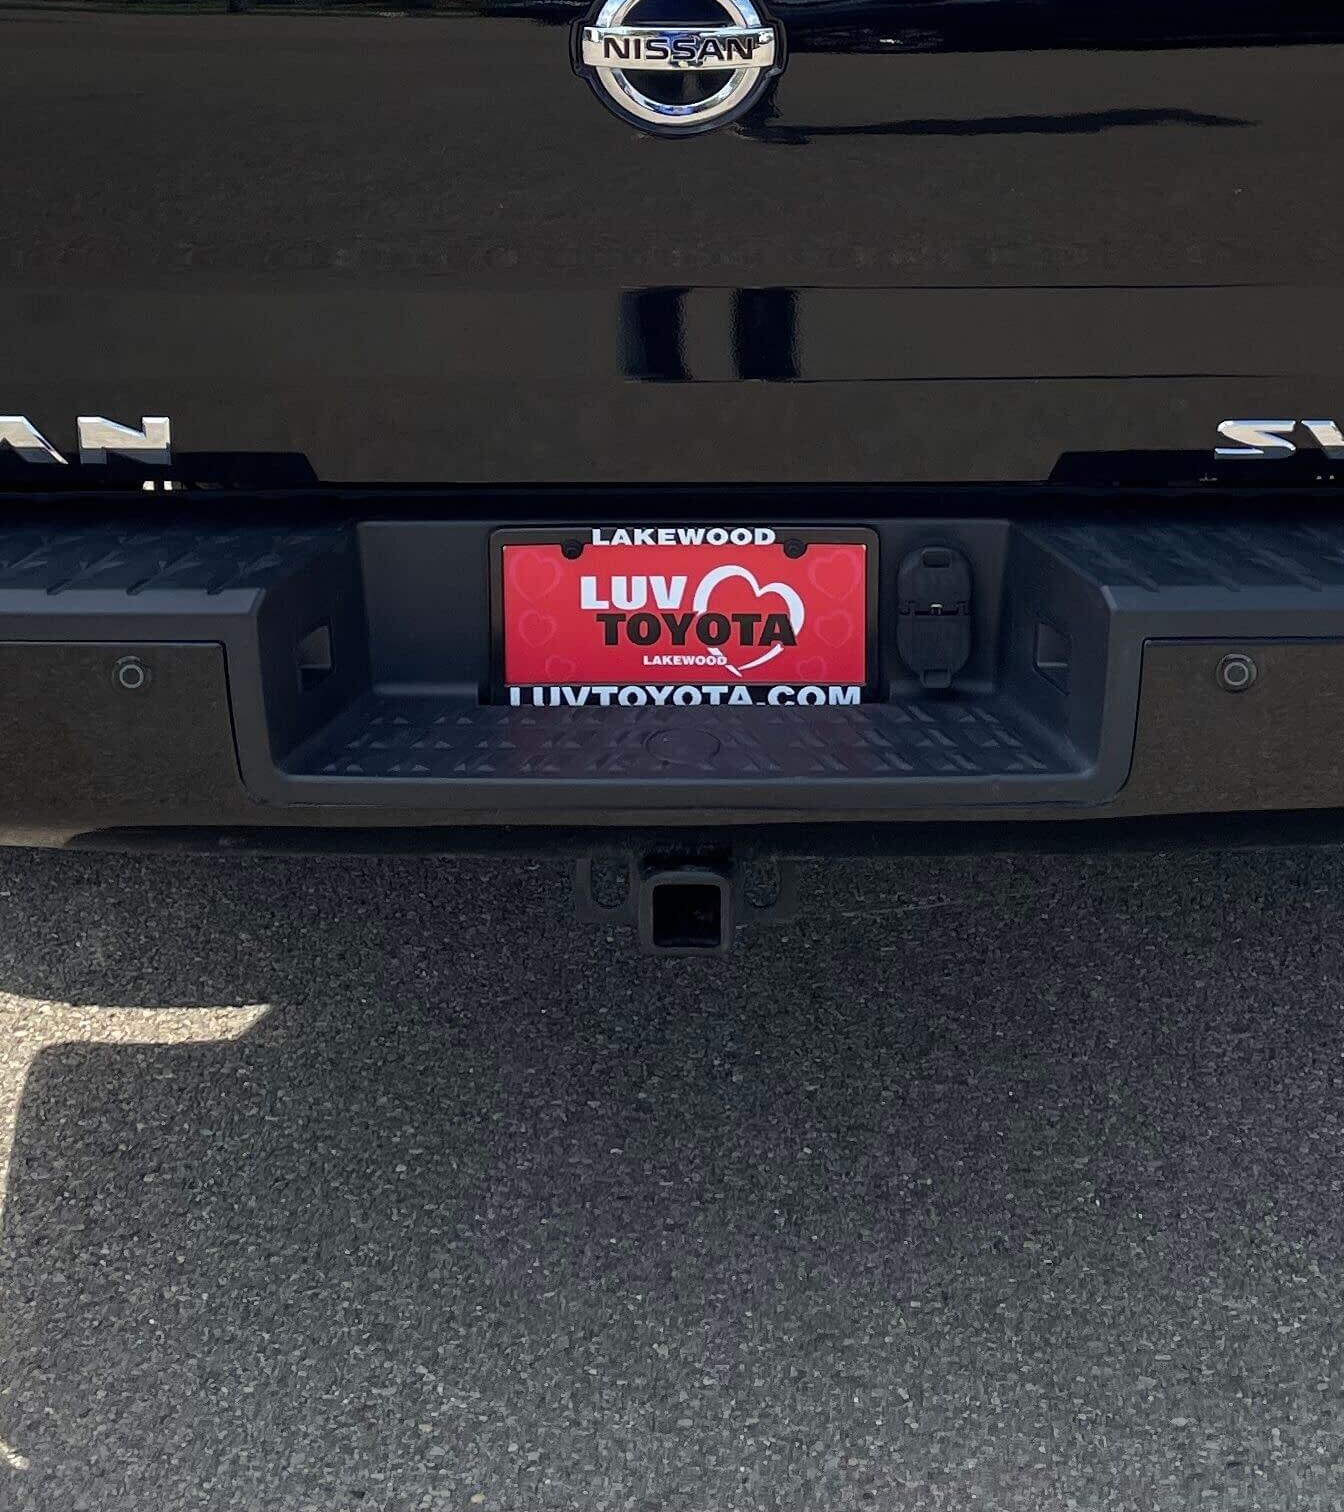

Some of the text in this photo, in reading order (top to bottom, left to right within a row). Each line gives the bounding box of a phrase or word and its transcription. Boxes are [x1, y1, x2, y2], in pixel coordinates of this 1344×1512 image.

[603, 36, 754, 61] NISSAN
[591, 528, 776, 546] LAKEWOOD
[580, 575, 688, 610] LUV
[596, 612, 798, 647] TOYOTA
[643, 655, 728, 666] LAKEWOOD
